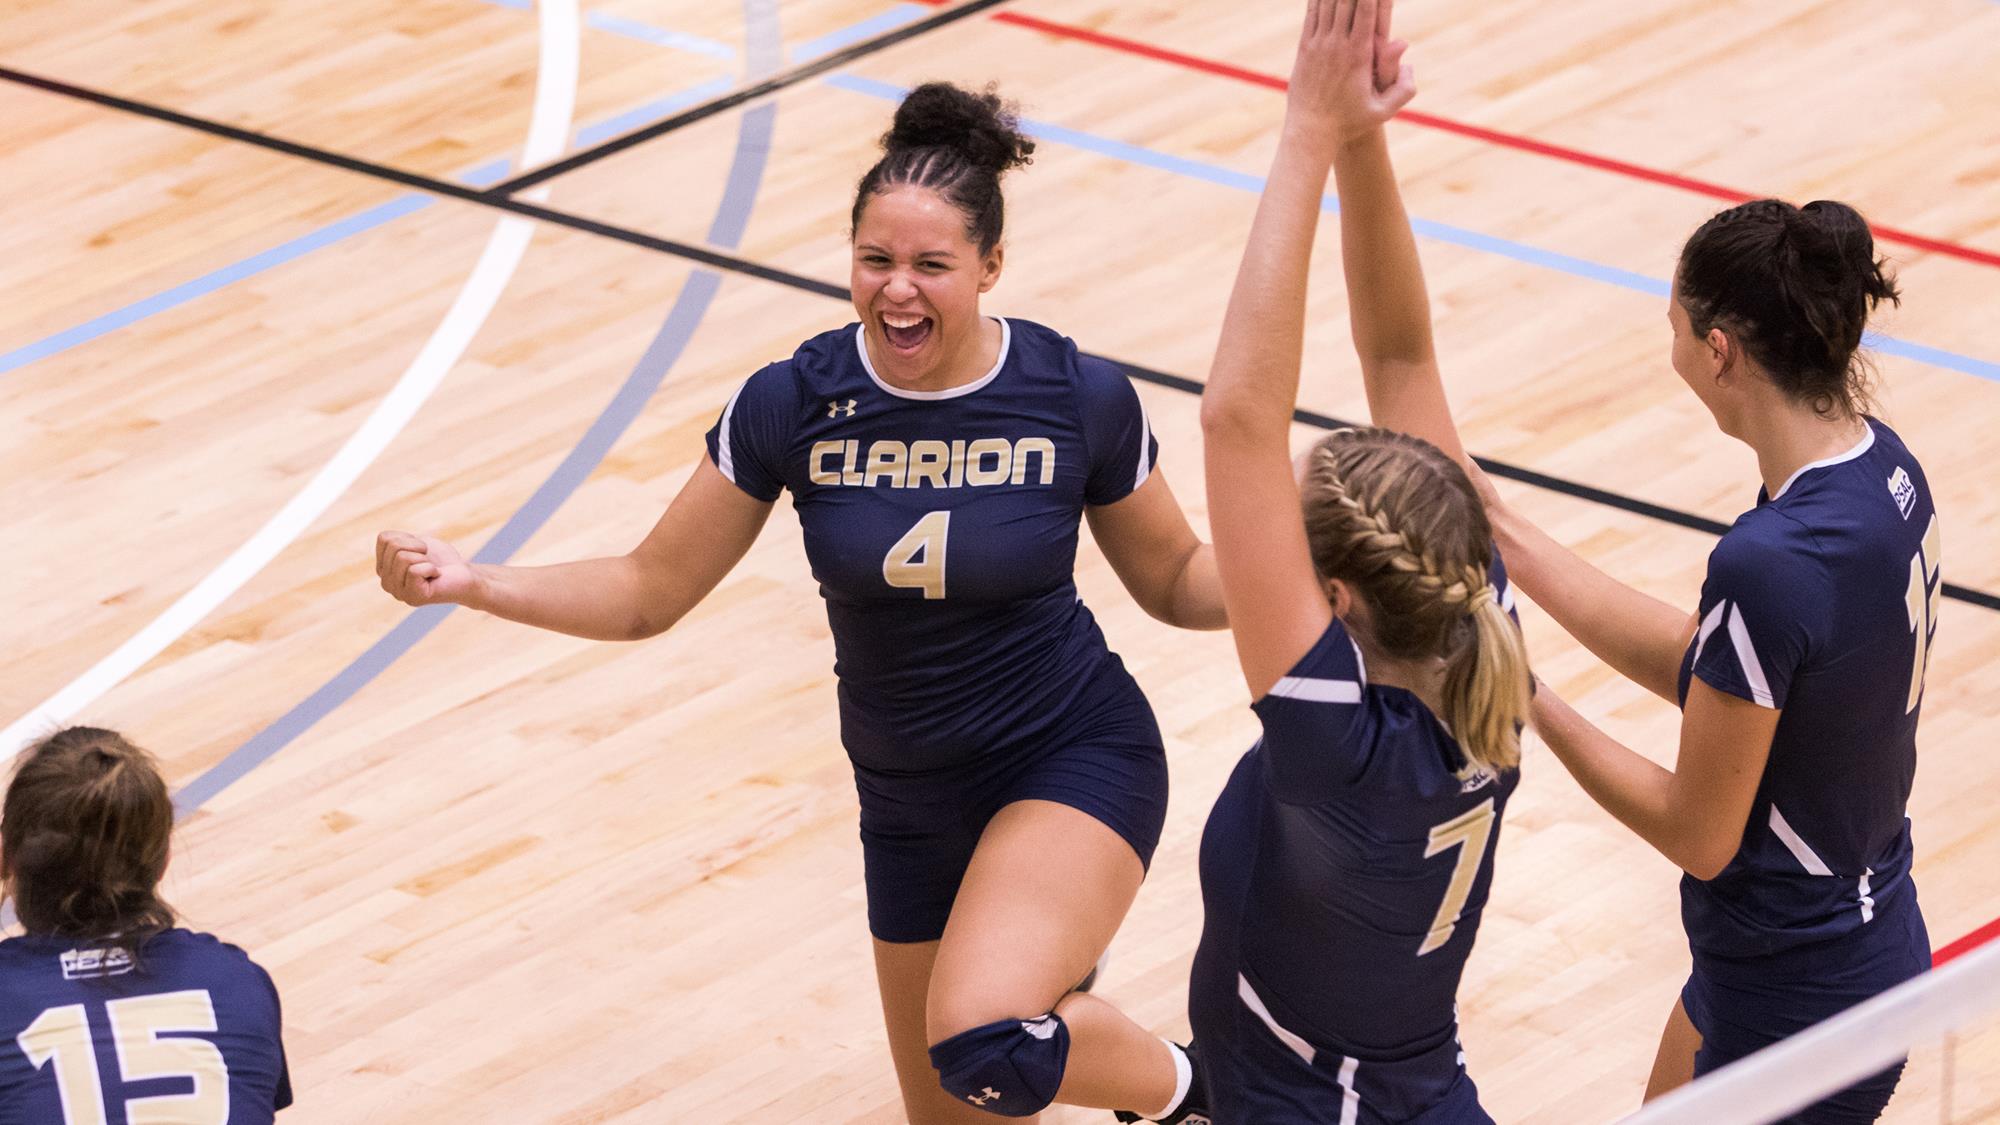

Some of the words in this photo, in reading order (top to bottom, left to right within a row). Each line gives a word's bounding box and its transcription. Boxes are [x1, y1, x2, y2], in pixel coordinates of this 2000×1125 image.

[809, 437, 1056, 489] CLARION
[882, 510, 951, 600] 4
[1416, 796, 1496, 957] 7
[16, 988, 230, 1125] 15
